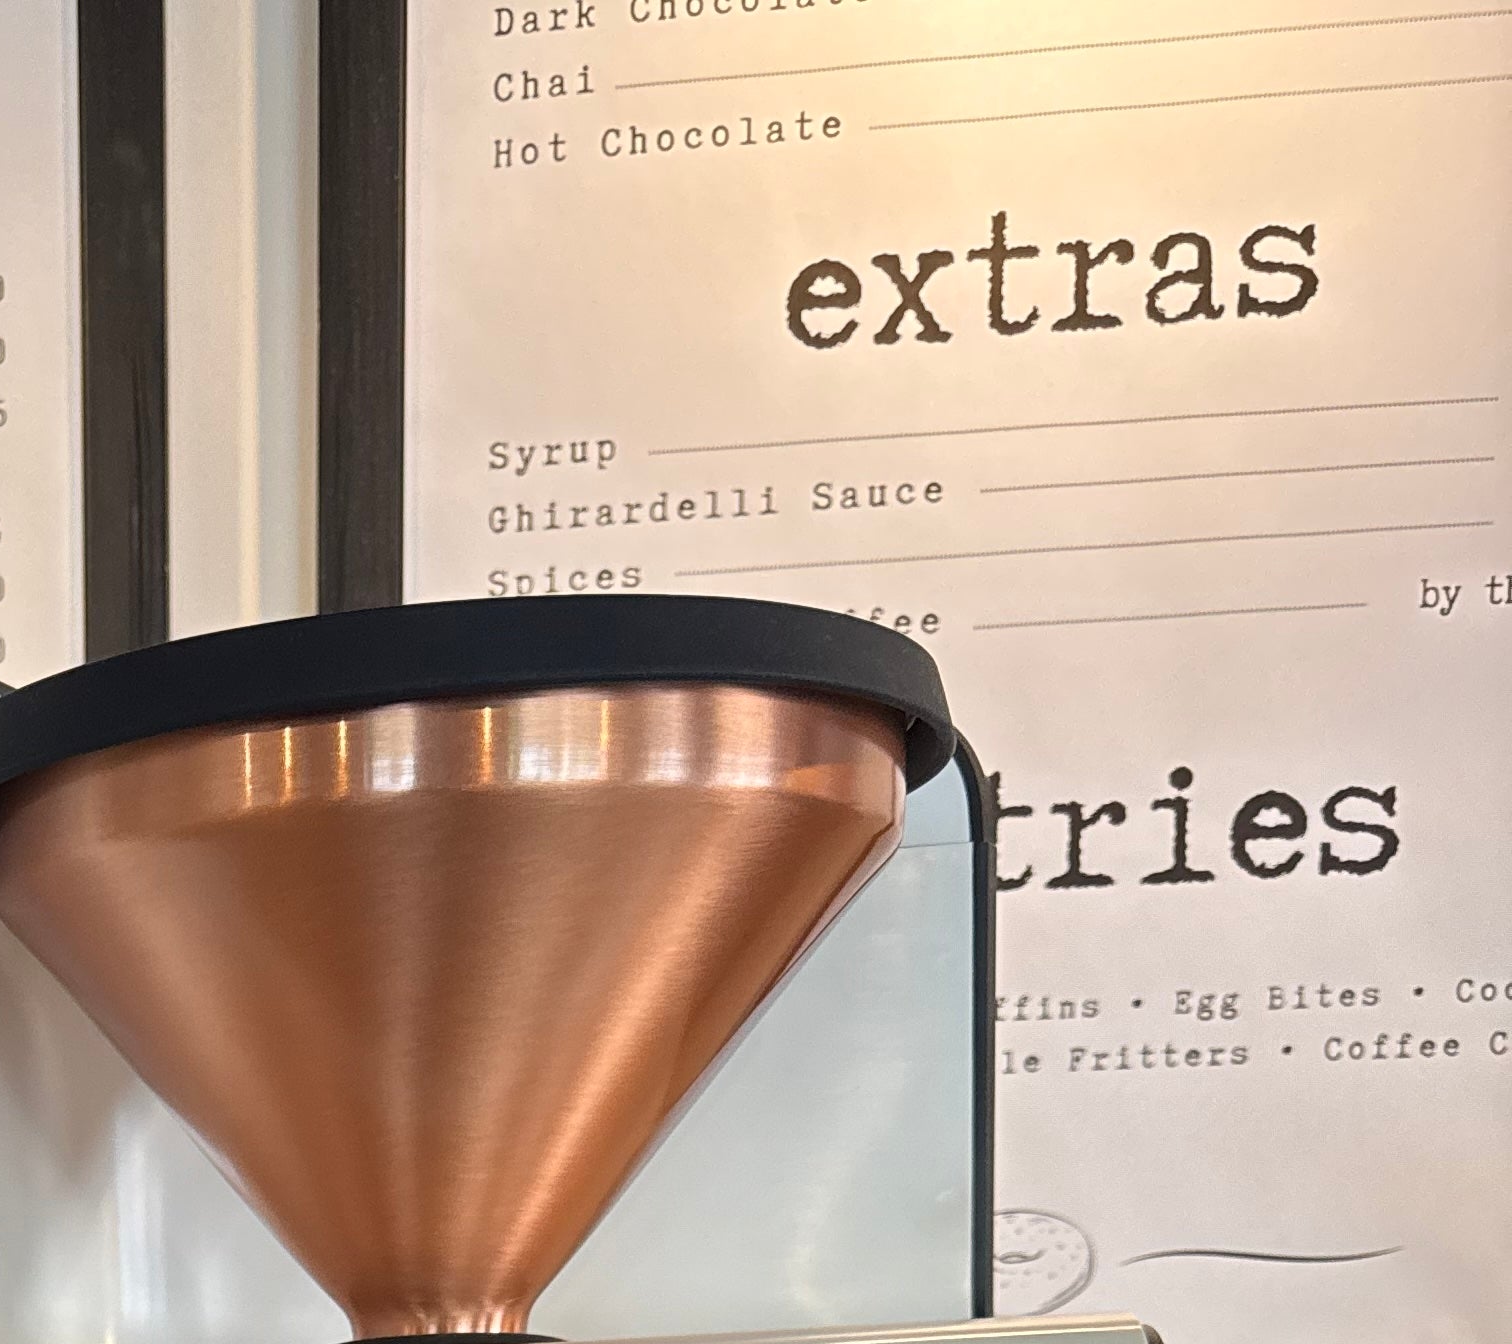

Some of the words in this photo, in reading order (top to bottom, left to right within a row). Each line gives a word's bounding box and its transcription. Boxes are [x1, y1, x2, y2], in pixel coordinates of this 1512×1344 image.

[493, 2, 597, 37] Dark
[493, 64, 595, 102] Chai
[492, 131, 569, 168] Hot
[601, 110, 843, 158] Chocolate
[786, 210, 1319, 350] extras
[487, 437, 617, 477] Syrup
[487, 484, 779, 535] Ghirardelli
[810, 480, 945, 512] Sauce
[1419, 578, 1462, 617] by
[1174, 989, 1240, 1021] Egg
[1267, 982, 1381, 1011] Bites
[1002, 1050, 1042, 1075] le
[1067, 1042, 1249, 1072] Fritters
[1323, 1032, 1461, 1061] Coffee
